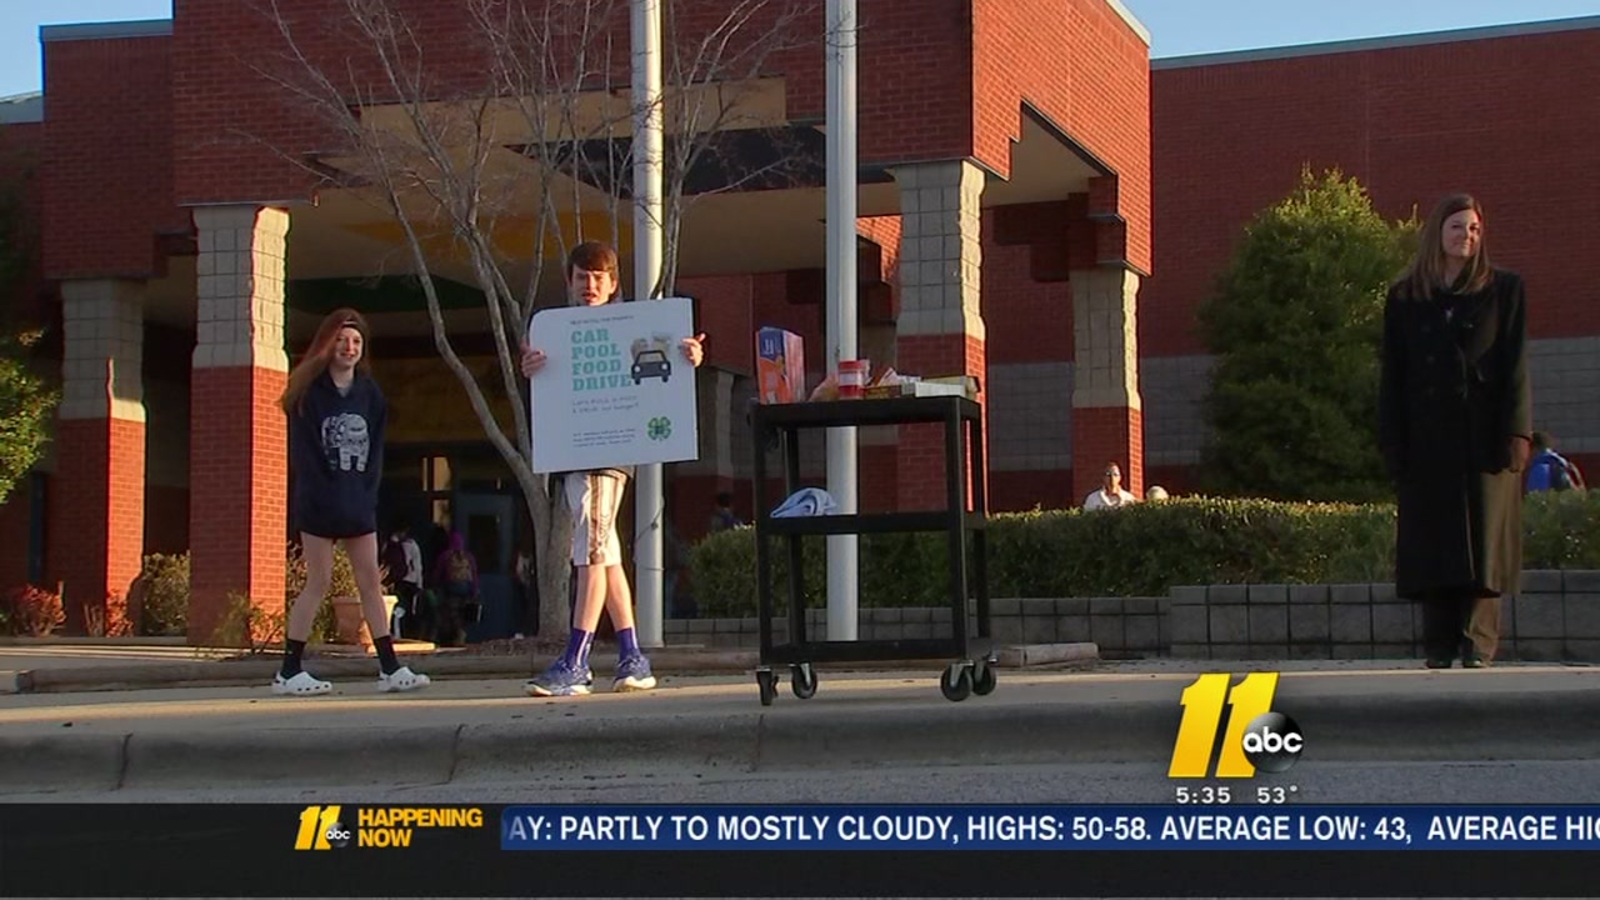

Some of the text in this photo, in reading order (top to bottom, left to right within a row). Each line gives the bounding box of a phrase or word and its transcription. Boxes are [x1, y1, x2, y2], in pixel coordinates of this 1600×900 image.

[571, 328, 609, 344] CAR
[571, 343, 621, 360] POOL
[572, 359, 621, 376] FOOD
[572, 374, 632, 391] DRIVE
